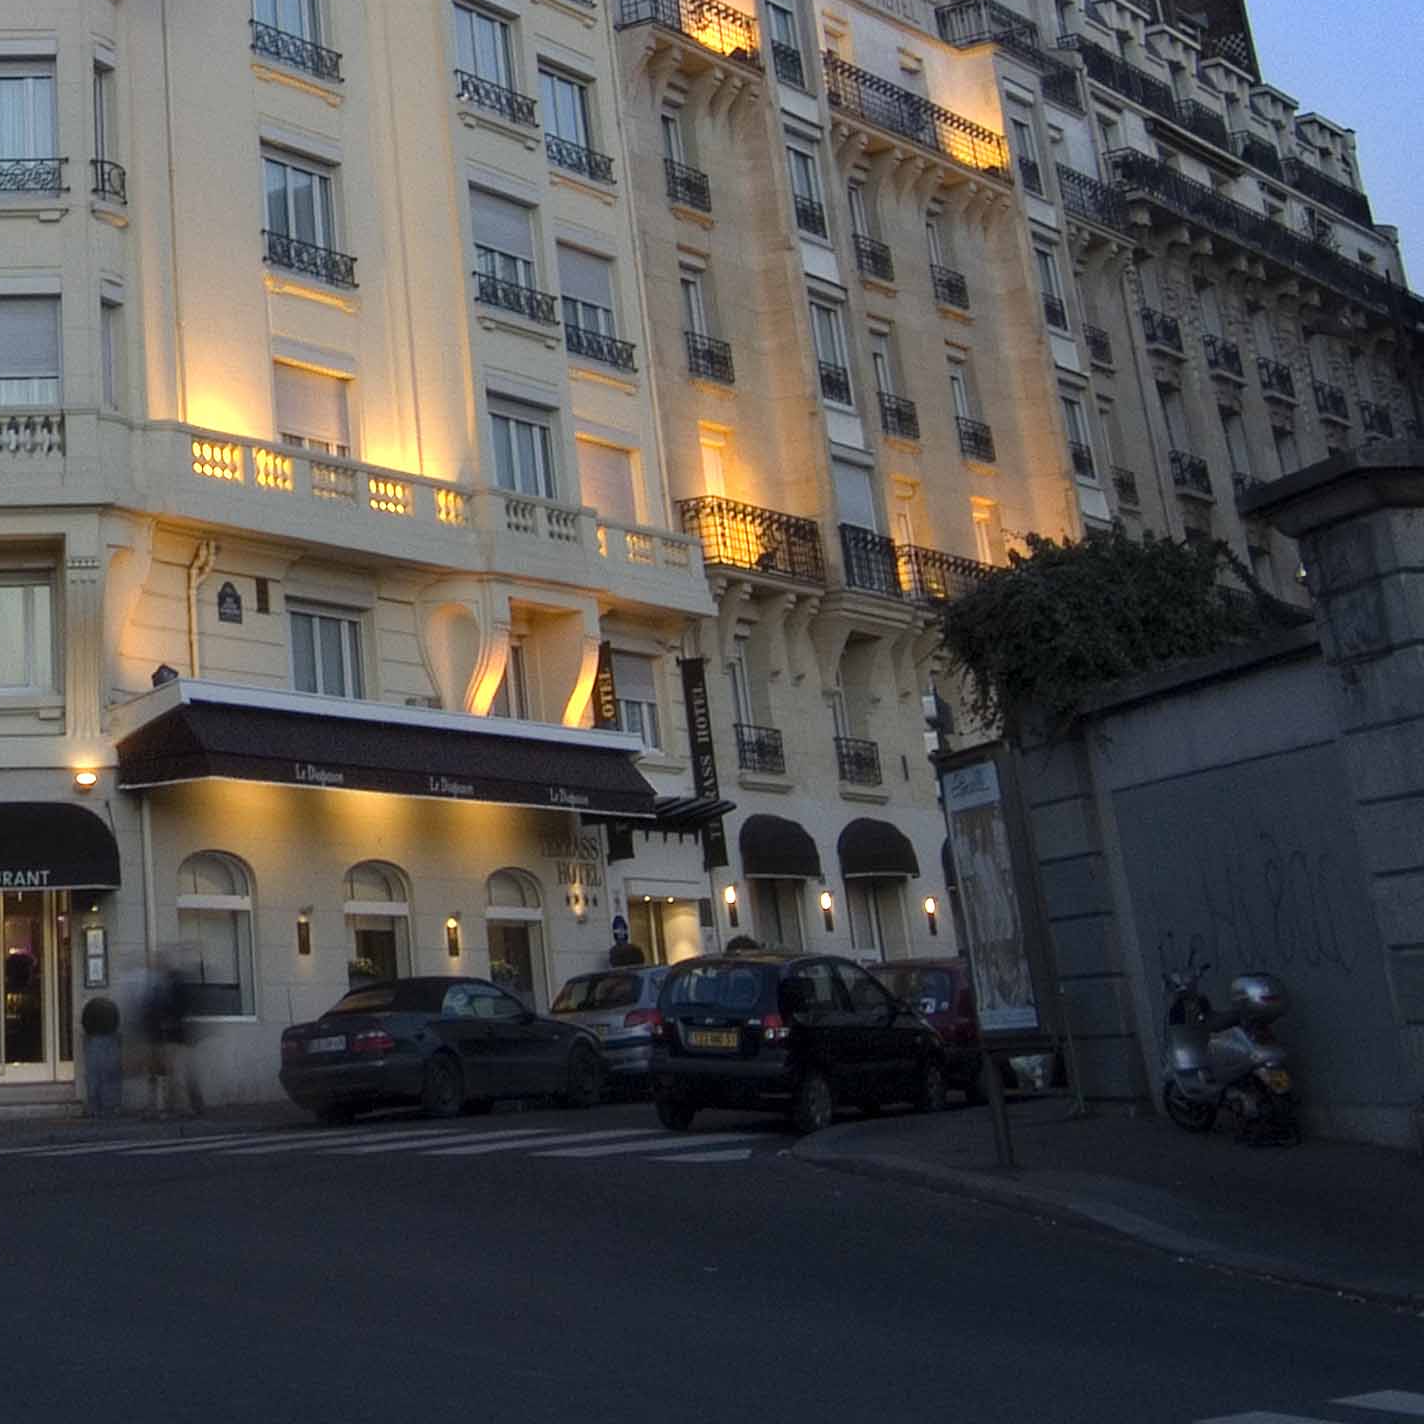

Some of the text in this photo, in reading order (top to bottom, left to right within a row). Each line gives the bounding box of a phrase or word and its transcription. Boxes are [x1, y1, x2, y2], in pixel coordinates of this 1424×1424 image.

[598, 666, 615, 719] OTEL
[691, 681, 720, 841] TRASS HOTEL
